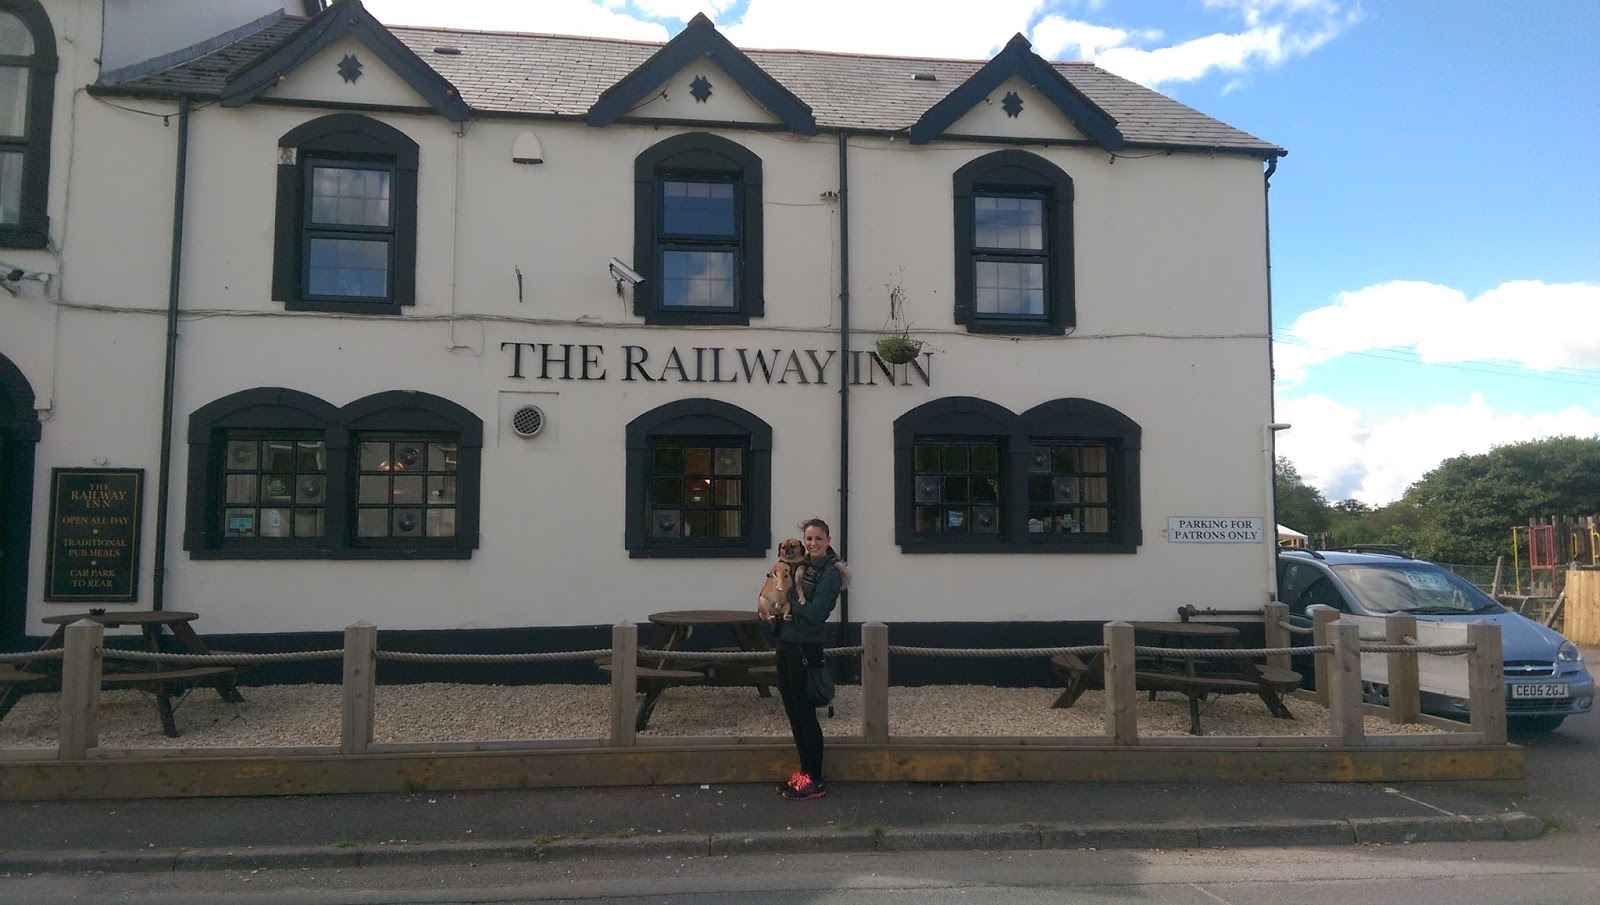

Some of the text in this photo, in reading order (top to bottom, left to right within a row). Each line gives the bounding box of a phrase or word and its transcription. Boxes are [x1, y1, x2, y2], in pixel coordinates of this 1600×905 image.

[500, 342, 935, 387] THE RAILWAY INN
[89, 483, 110, 491] THE
[71, 490, 127, 501] RAILWAY
[86, 500, 111, 509] INN
[62, 516, 129, 525] OPEN ALL DAY
[1179, 520, 1253, 530] PARKING FOR
[1174, 530, 1258, 540] PATRONS ONLY
[64, 539, 127, 547] TRADITIONAL
[68, 549, 120, 557] PUB MEALS
[69, 569, 116, 578] CAR PARK
[72, 580, 113, 588] TO REAR
[1545, 685, 1566, 696] ZGJ
